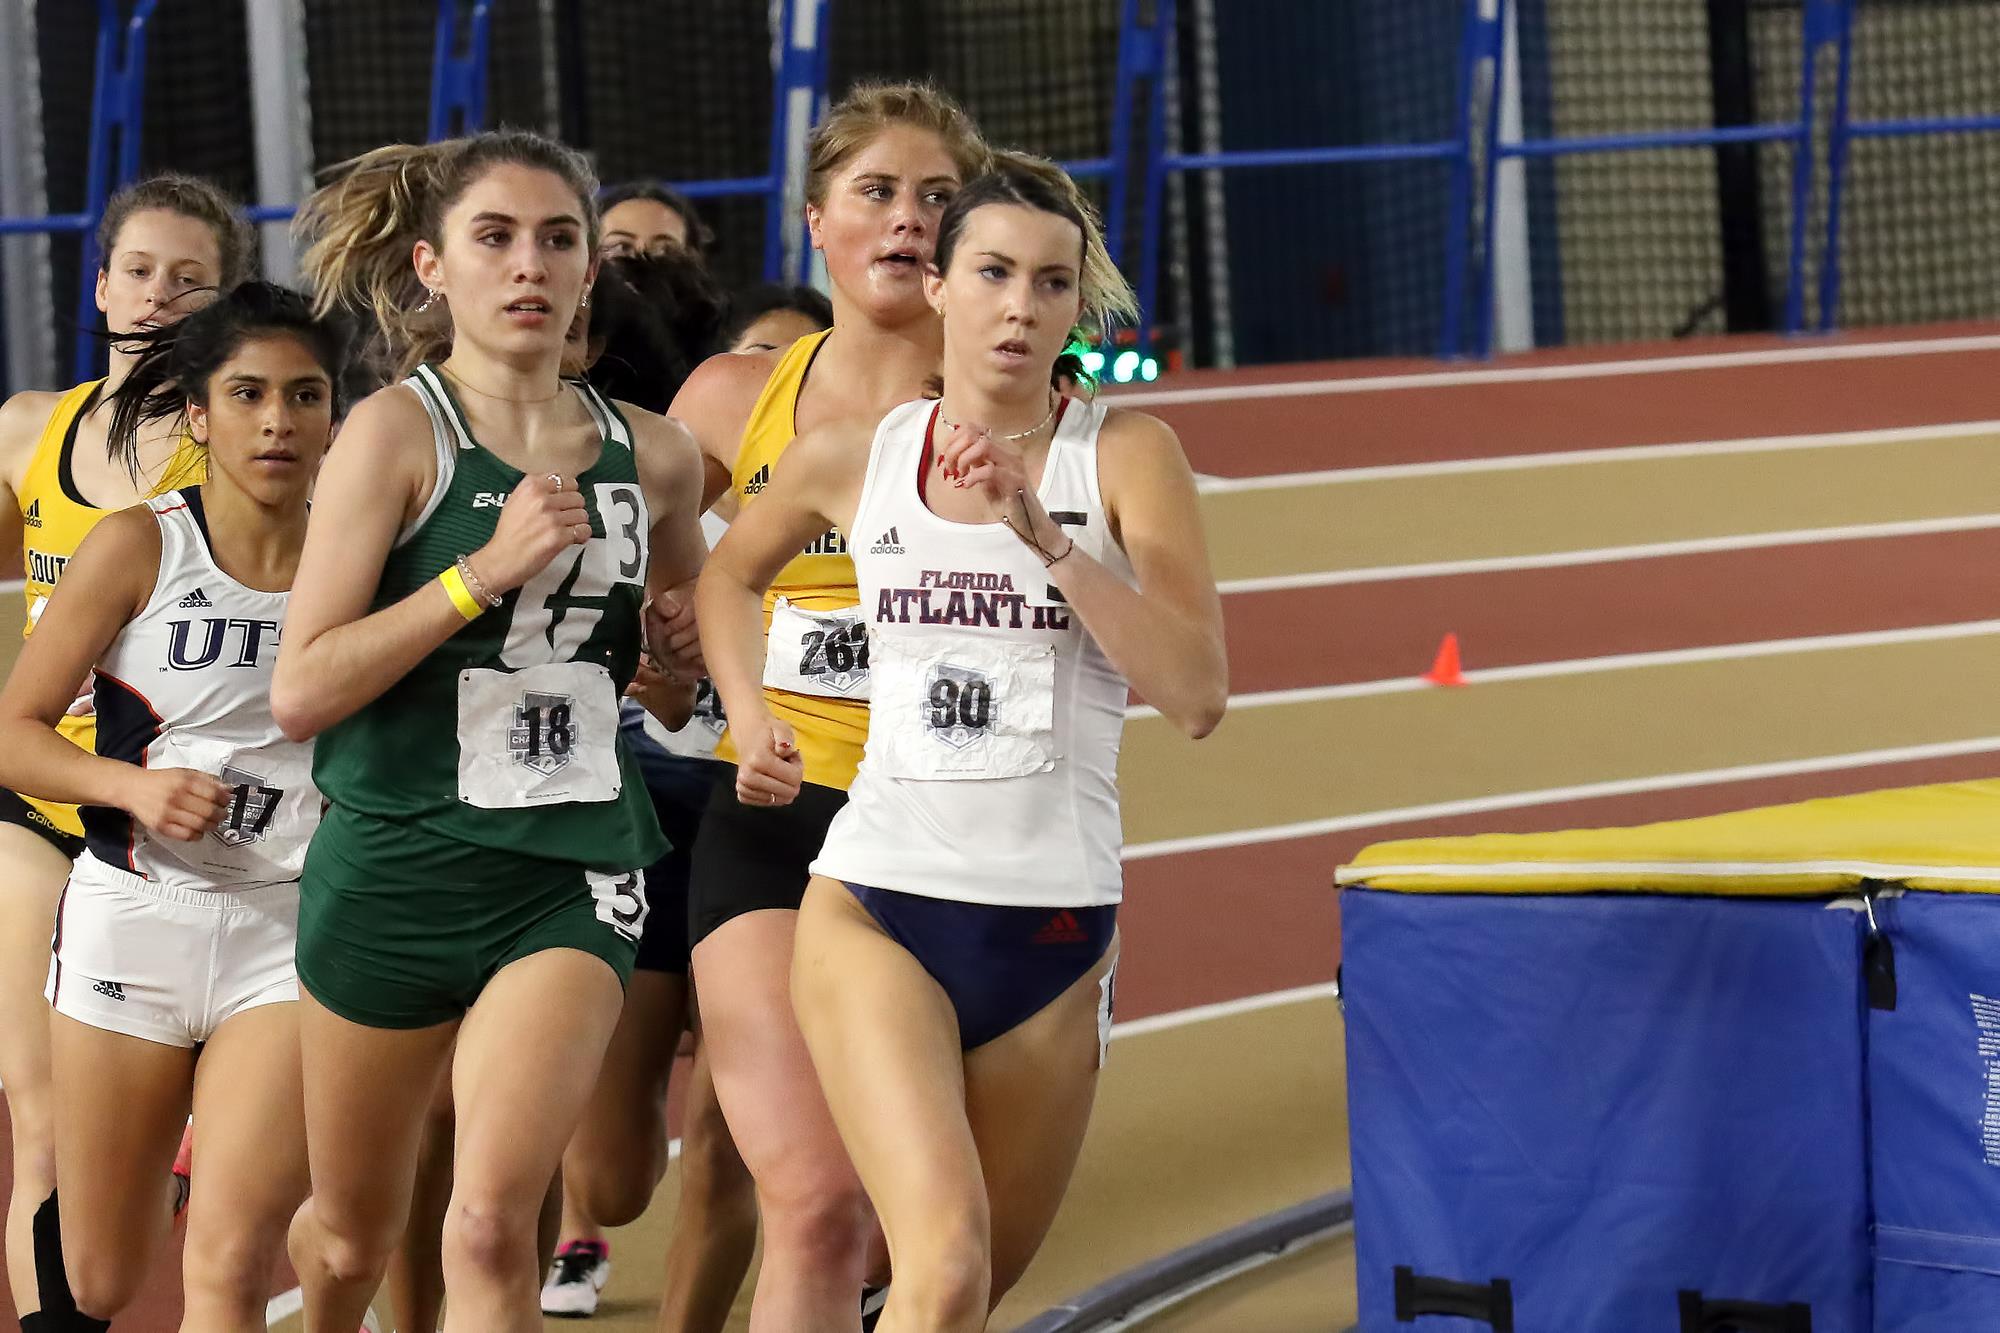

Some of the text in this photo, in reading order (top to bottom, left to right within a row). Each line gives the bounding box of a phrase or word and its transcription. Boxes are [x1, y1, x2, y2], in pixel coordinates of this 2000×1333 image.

[611, 488, 642, 579] 3
[870, 542, 906, 555] adidas
[28, 549, 72, 585] SOUT
[919, 570, 1014, 592] FLORIDA
[178, 600, 213, 608] adidas
[165, 618, 283, 671] UT
[930, 679, 991, 729] 90
[521, 703, 570, 757] 18
[230, 783, 284, 834] 17
[92, 983, 126, 1002] adidas
